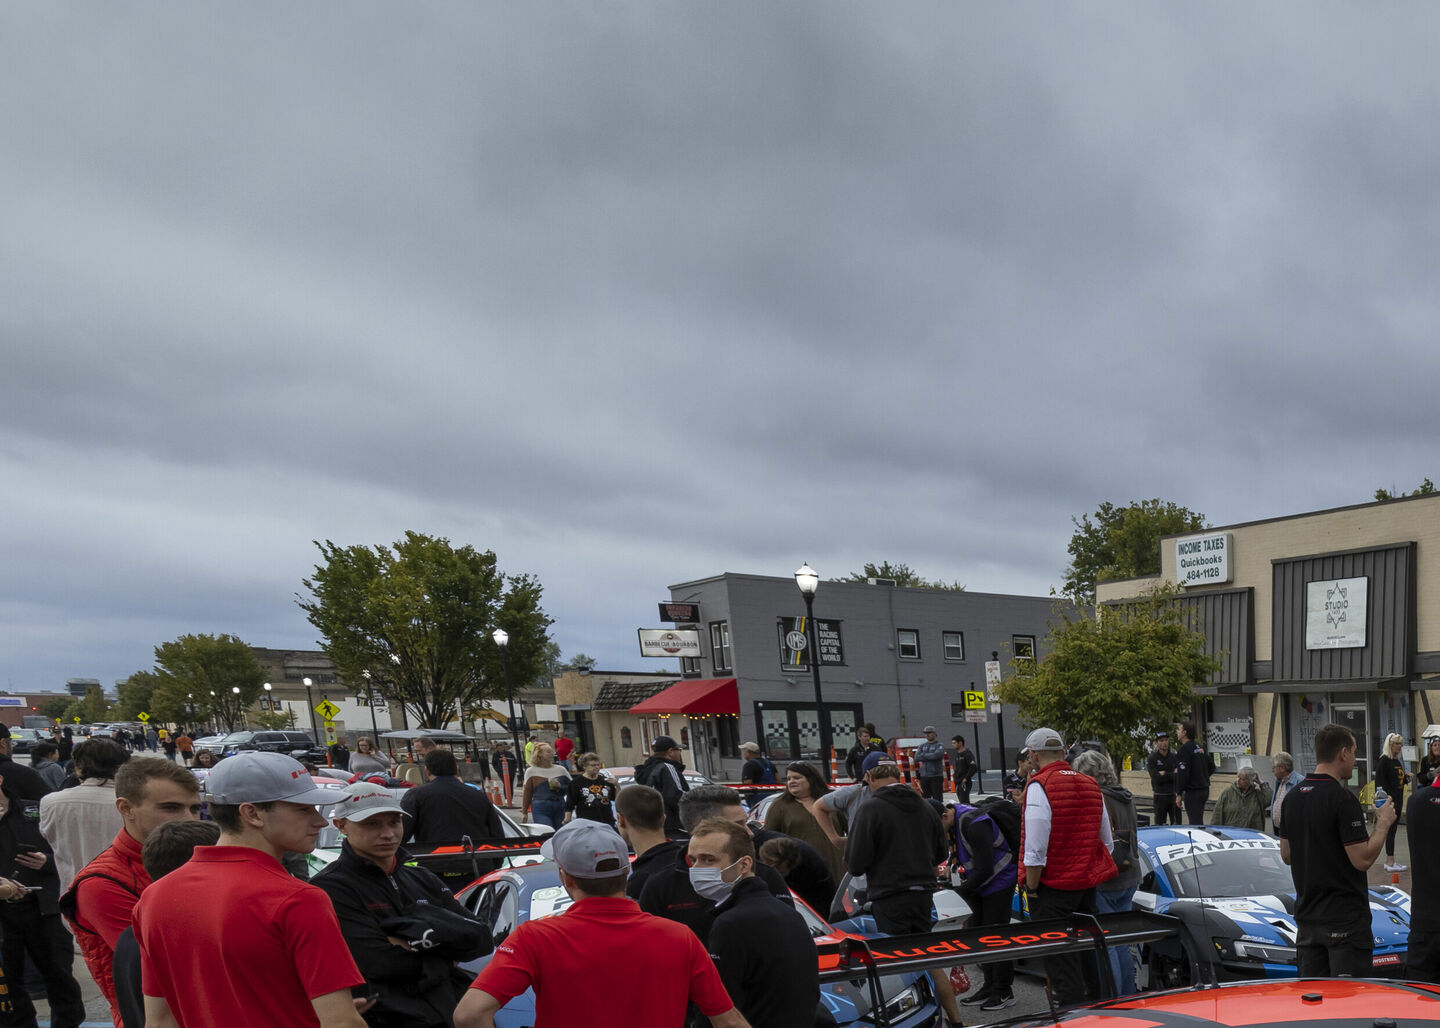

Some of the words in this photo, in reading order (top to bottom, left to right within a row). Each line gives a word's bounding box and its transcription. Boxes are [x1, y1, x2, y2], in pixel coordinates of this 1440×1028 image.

[1178, 541, 1201, 555] INCOME
[1203, 537, 1225, 551] TAXES
[1180, 554, 1222, 568] Quickbooks
[1187, 567, 1220, 580] 484-1128
[1325, 600, 1349, 610] STUDIO
[818, 623, 829, 631] THE
[819, 631, 839, 639] RACING
[820, 639, 841, 647] CAPITAL
[822, 654, 841, 662] WORLD
[1167, 838, 1283, 860] FANATE
[861, 938, 971, 962] Audi
